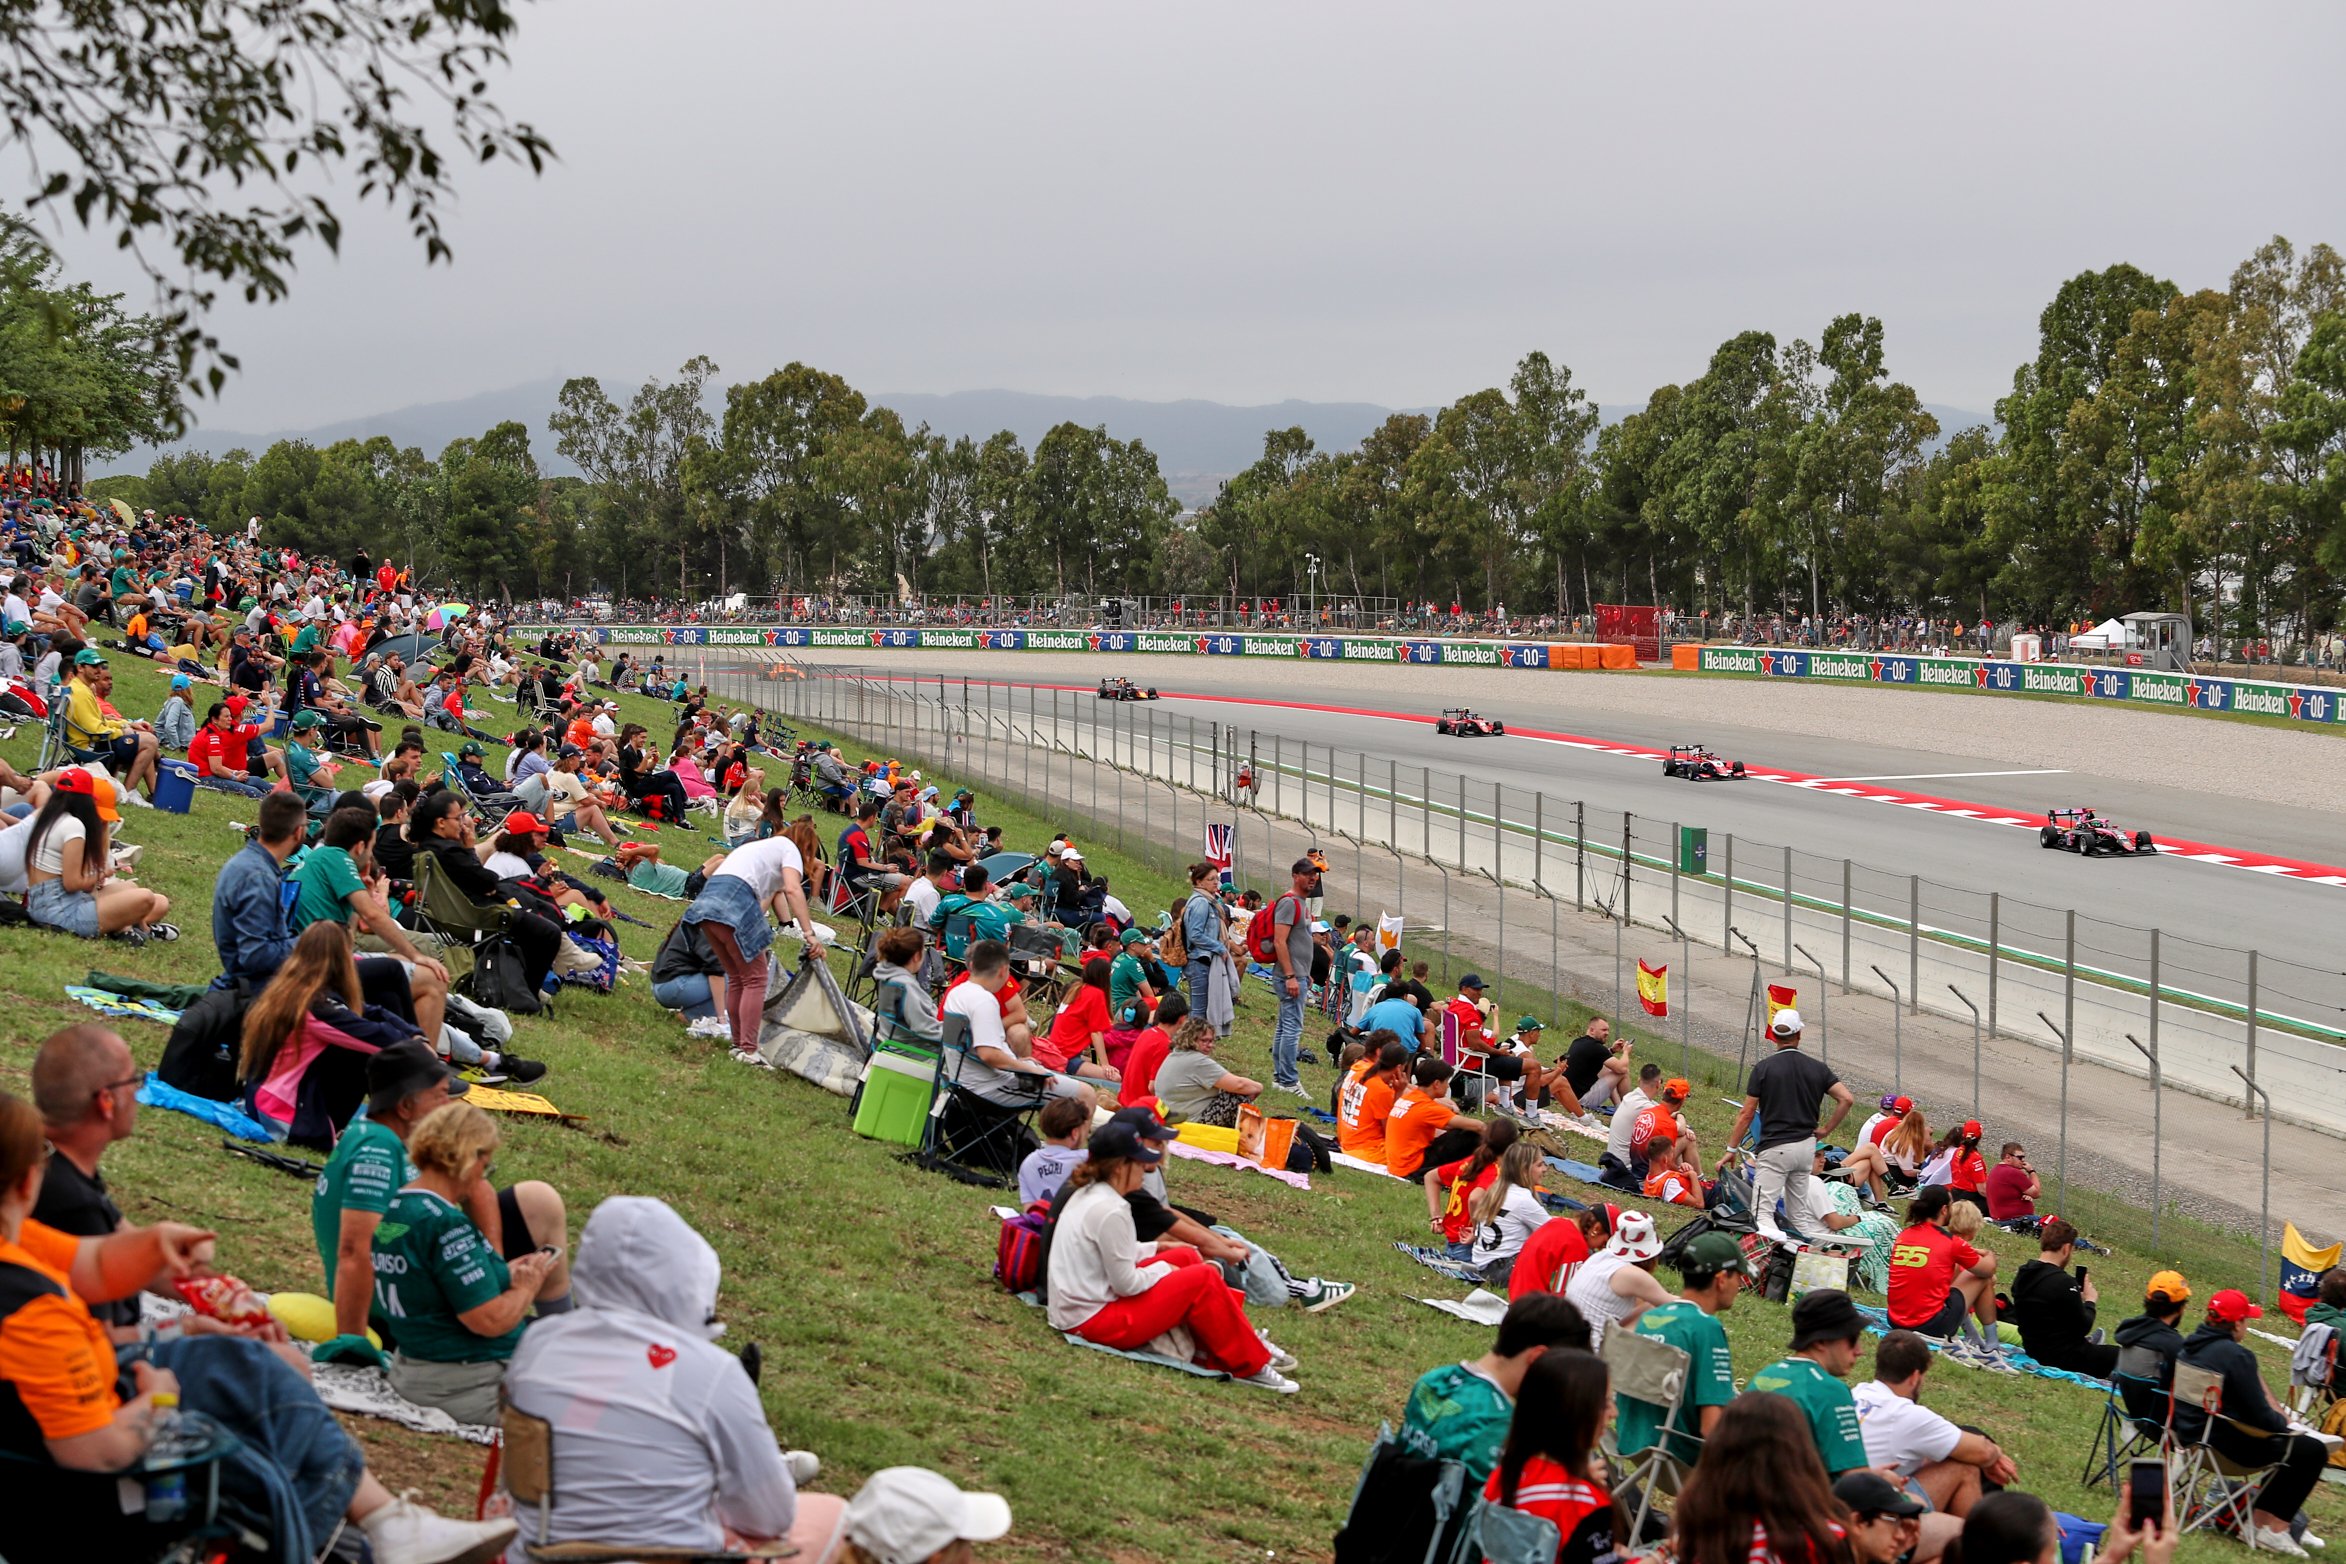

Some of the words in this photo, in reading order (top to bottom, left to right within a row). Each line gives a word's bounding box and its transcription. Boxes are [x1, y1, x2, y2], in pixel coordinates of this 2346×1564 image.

[610, 629, 659, 644] Heineken
[708, 630, 759, 645] Heineken
[812, 631, 866, 646] Heineken
[921, 632, 973, 648] Heineken
[1028, 633, 1083, 649] Heineken
[1138, 635, 1191, 652] Heineken
[1245, 638, 1295, 656] Heineken
[1344, 642, 1394, 659] Heineken
[1443, 645, 1497, 664] Heineken
[1704, 651, 1757, 672] Heineken
[1811, 657, 1866, 678] Heineken
[1920, 662, 1971, 685] Heineken
[2024, 669, 2078, 692] Heineken
[2131, 677, 2183, 702] Heineken
[2234, 687, 2285, 714] Heineken
[1893, 1244, 1931, 1268] 55
